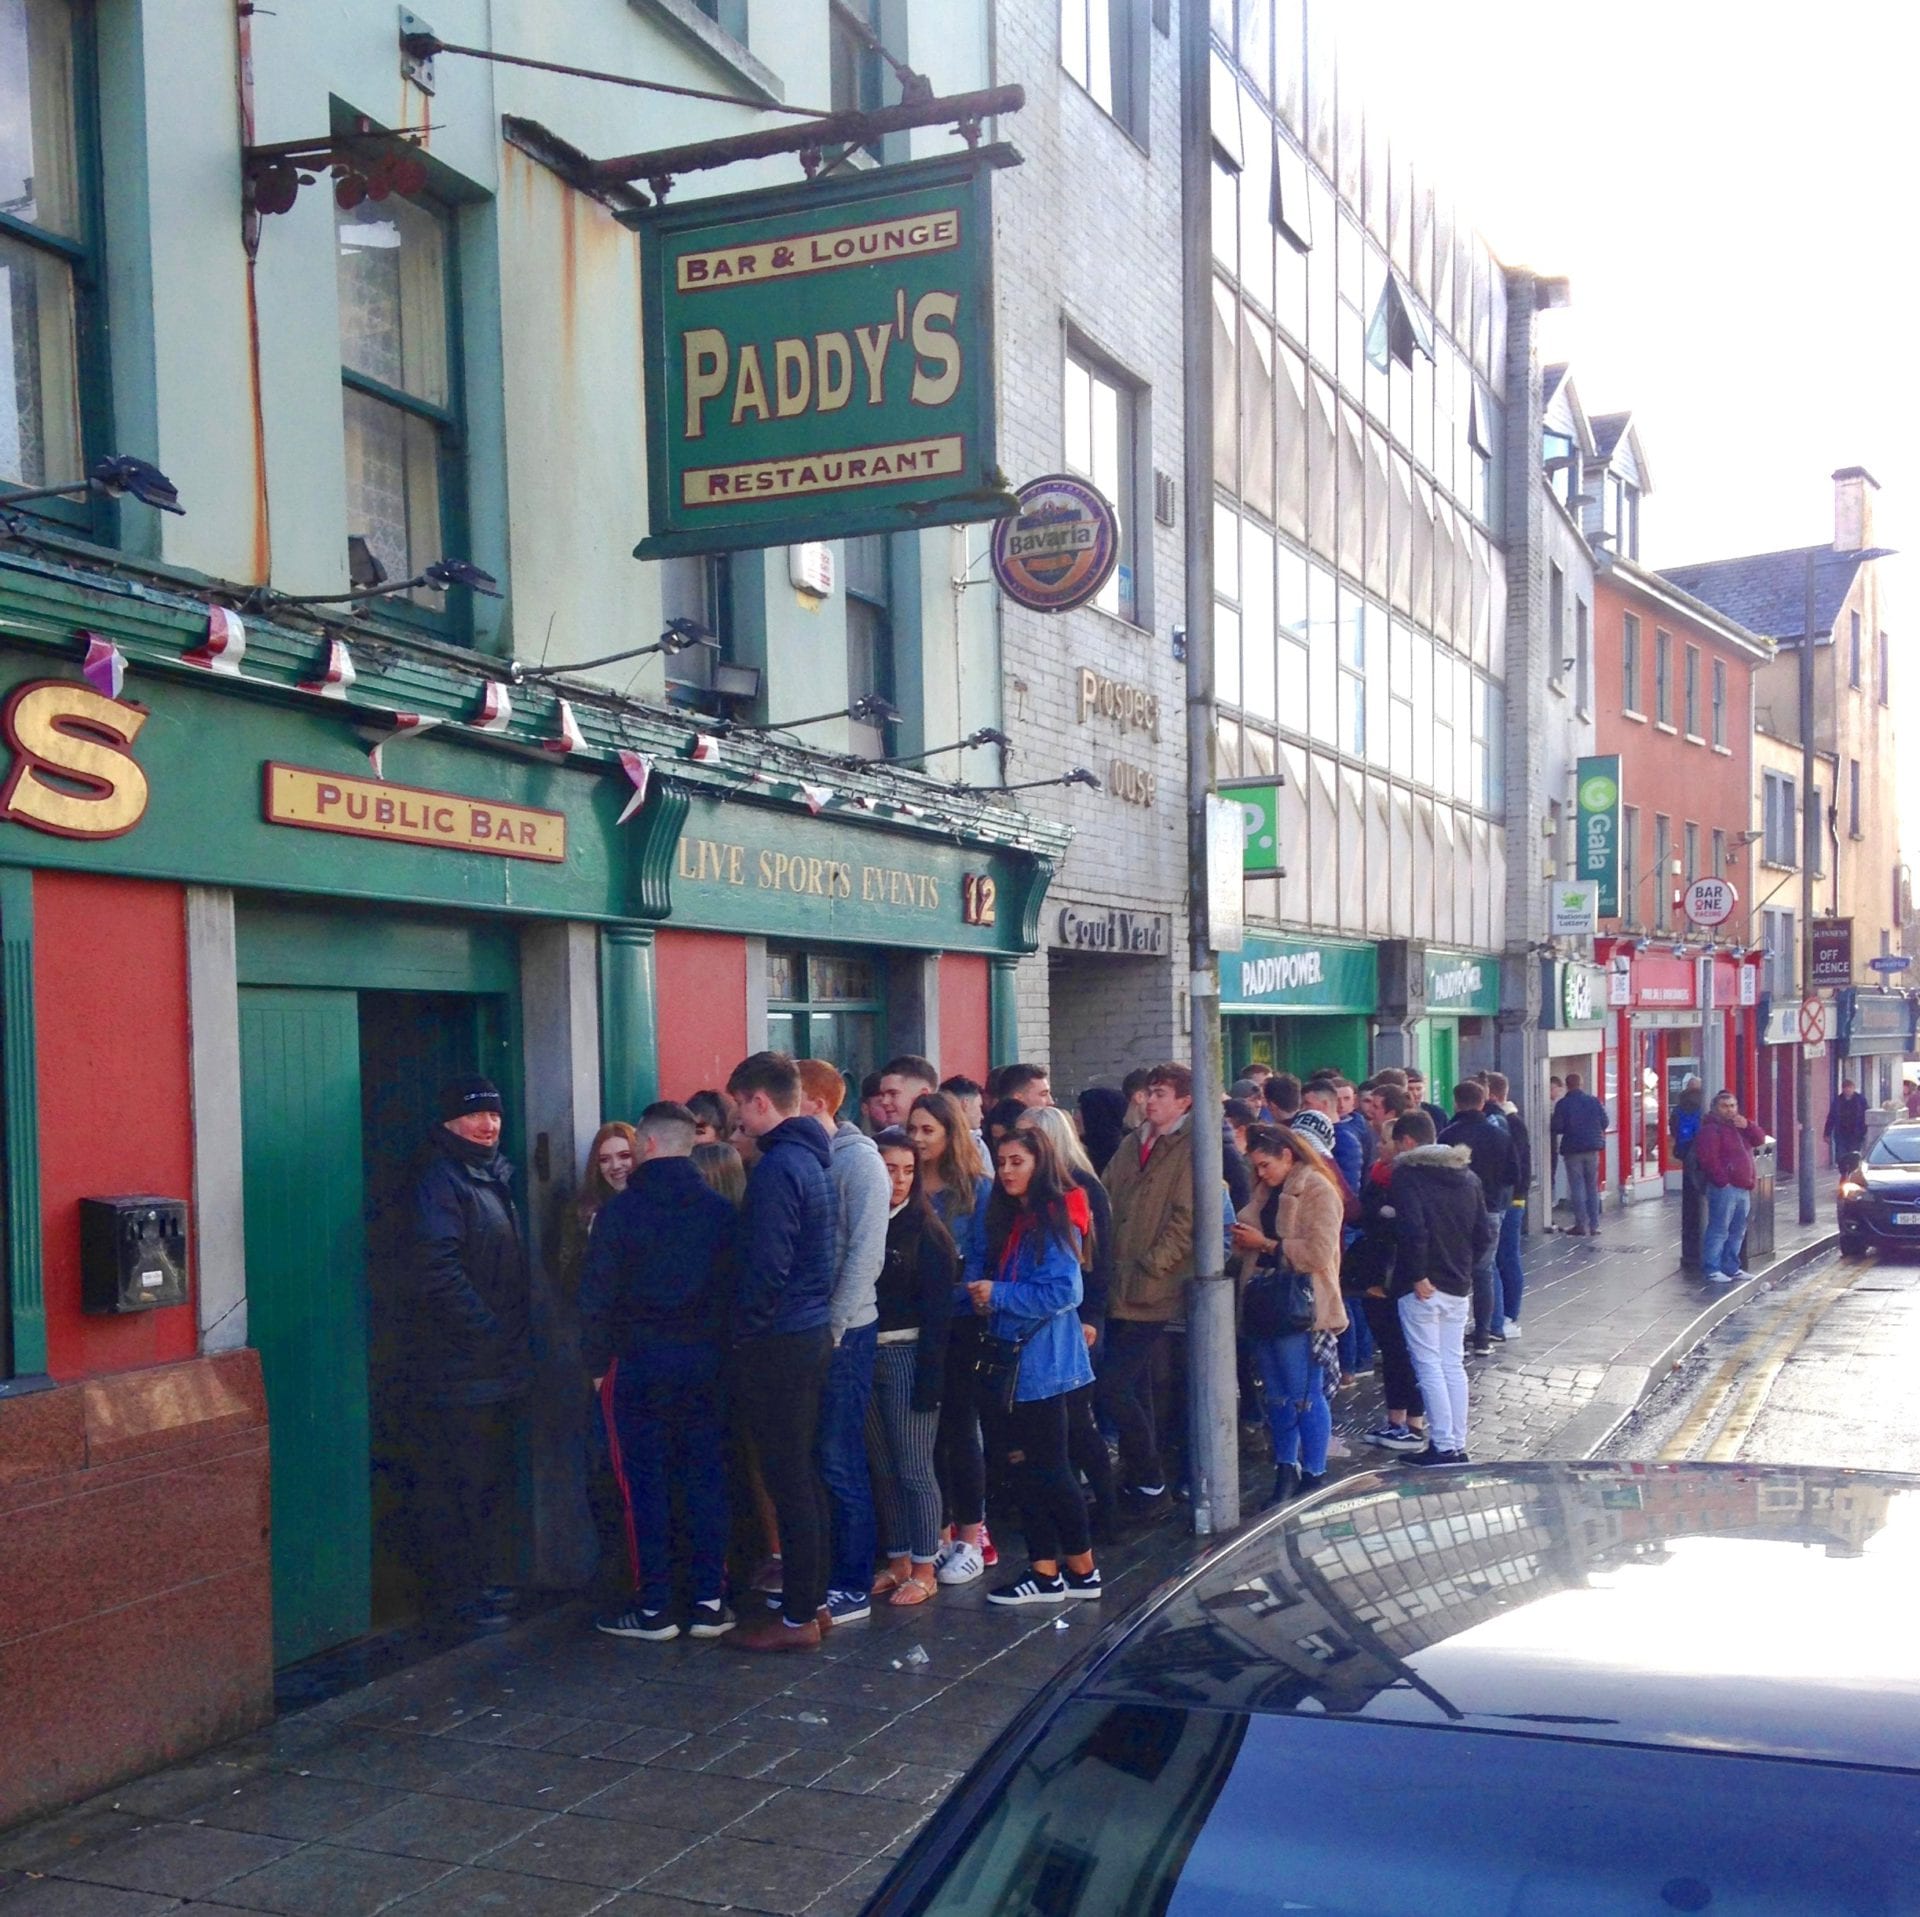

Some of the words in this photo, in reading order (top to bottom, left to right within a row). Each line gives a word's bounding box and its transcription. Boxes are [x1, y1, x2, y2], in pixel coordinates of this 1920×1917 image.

[685, 253, 757, 283] BAR
[771, 245, 795, 268] &
[810, 219, 953, 263] LOUNGE
[683, 288, 963, 439] PADDY'S
[708, 449, 939, 497] RESTAURANT
[1009, 525, 1090, 555] Bavaria
[1077, 666, 1161, 743] Prospect
[2, 680, 150, 838] S
[316, 782, 455, 833] PUBLIC
[470, 809, 536, 846] BAR
[1588, 813, 1611, 870] Gala
[678, 838, 745, 886] LIVE
[758, 849, 851, 898] SPORTS
[863, 866, 939, 910] EVENTS
[963, 872, 996, 926] 12
[1695, 886, 1723, 898] BAR
[1695, 899, 1722, 910] ONE
[1820, 949, 1839, 960] OFF
